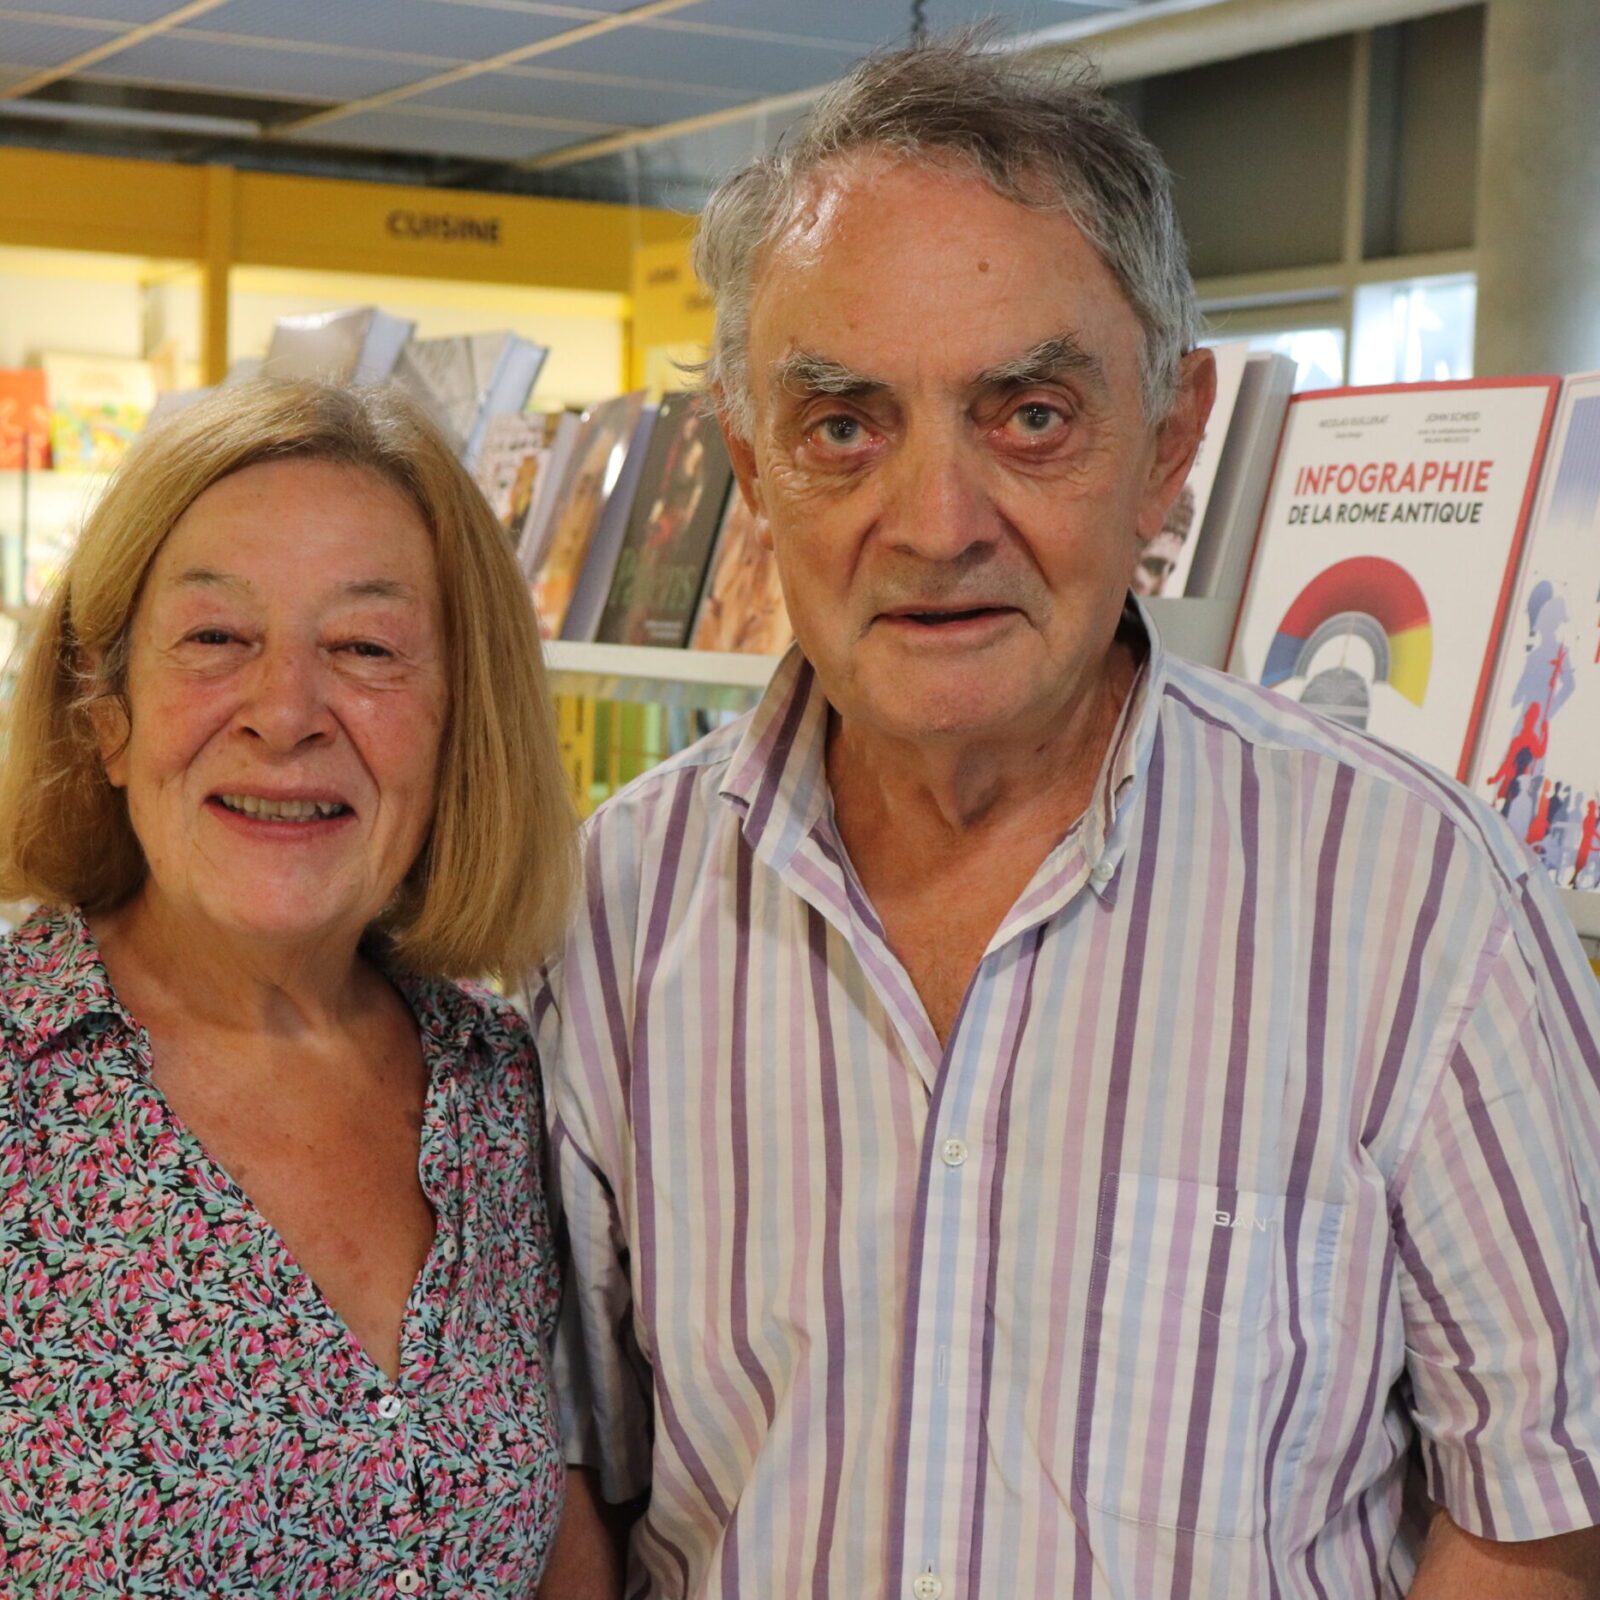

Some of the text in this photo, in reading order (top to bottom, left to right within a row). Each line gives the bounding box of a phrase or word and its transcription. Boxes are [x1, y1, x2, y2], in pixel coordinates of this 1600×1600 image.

[385, 209, 501, 245] CUISINE
[1294, 461, 1494, 496] INFOGRAPHIE
[1287, 502, 1483, 525] DE LA ROME ANTIQUE
